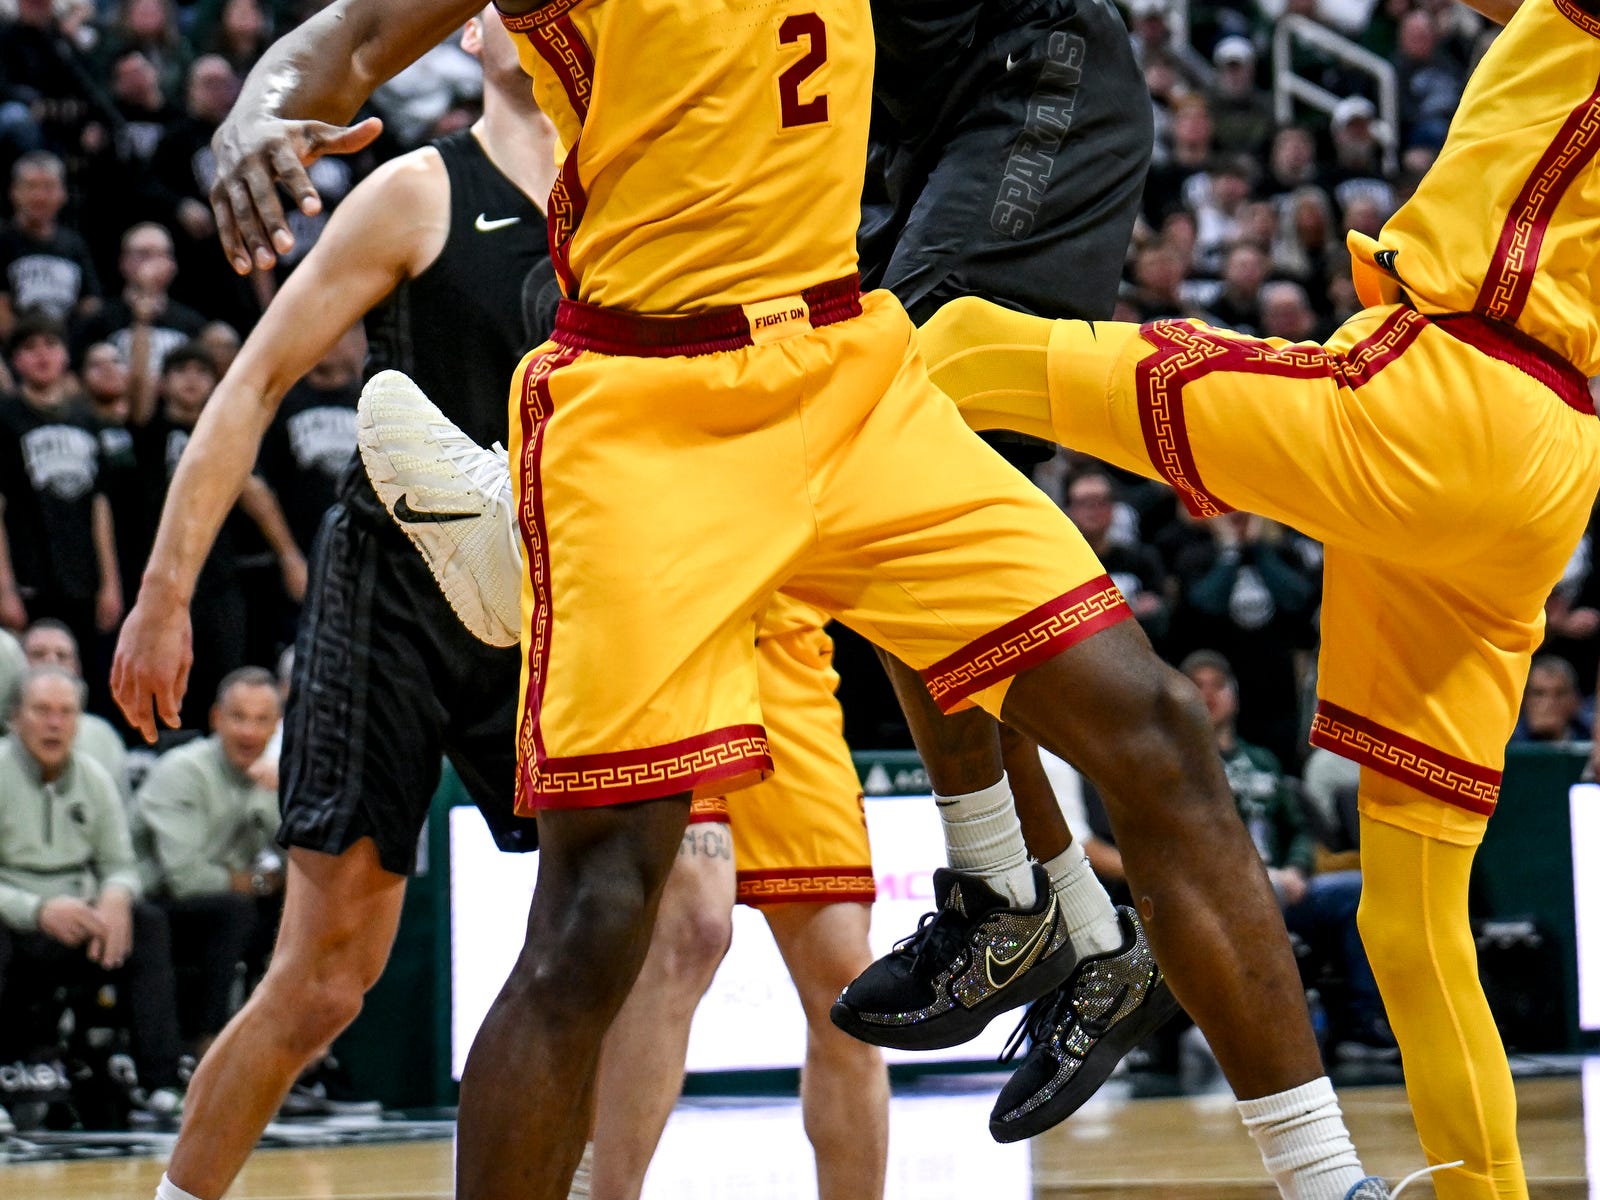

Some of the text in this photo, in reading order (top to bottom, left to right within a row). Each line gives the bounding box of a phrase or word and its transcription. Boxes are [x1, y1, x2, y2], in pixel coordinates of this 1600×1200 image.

[778, 11, 829, 129] 2
[990, 30, 1086, 238] SPARTANS
[754, 307, 805, 329] FIGHT ON
